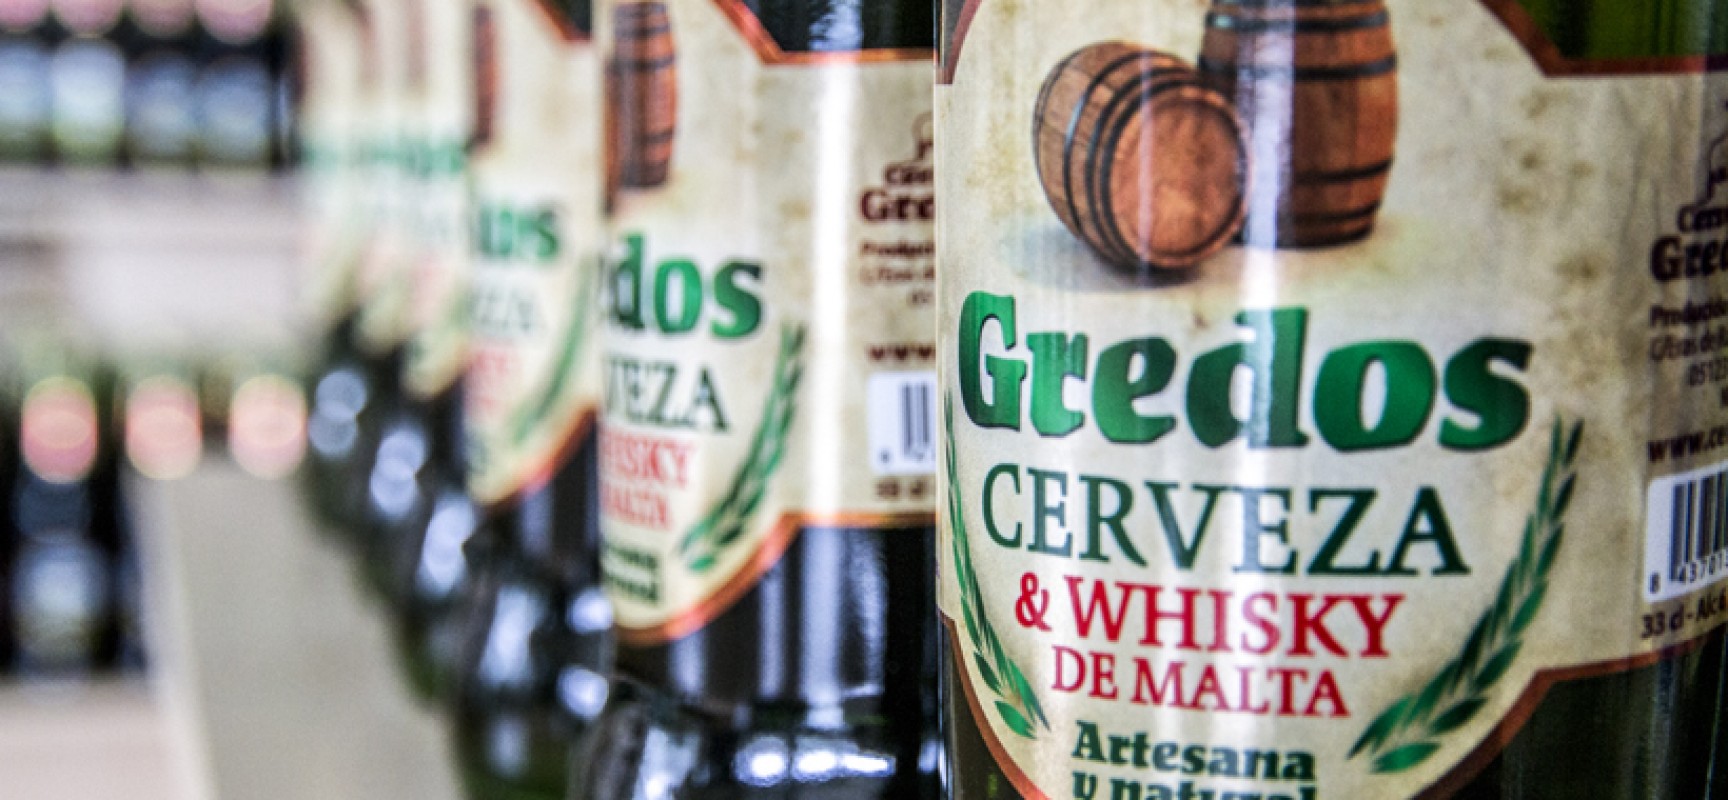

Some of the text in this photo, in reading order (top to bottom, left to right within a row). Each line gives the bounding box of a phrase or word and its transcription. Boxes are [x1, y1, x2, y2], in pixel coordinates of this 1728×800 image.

[606, 232, 764, 341] dos
[958, 290, 1533, 452] Gredos
[982, 462, 1471, 577] CERVEZA
[1015, 571, 1405, 658] & WHISKY
[1642, 611, 1666, 638] 33
[1051, 643, 1351, 717] DE MALTA
[1071, 719, 1316, 781] Artesana
